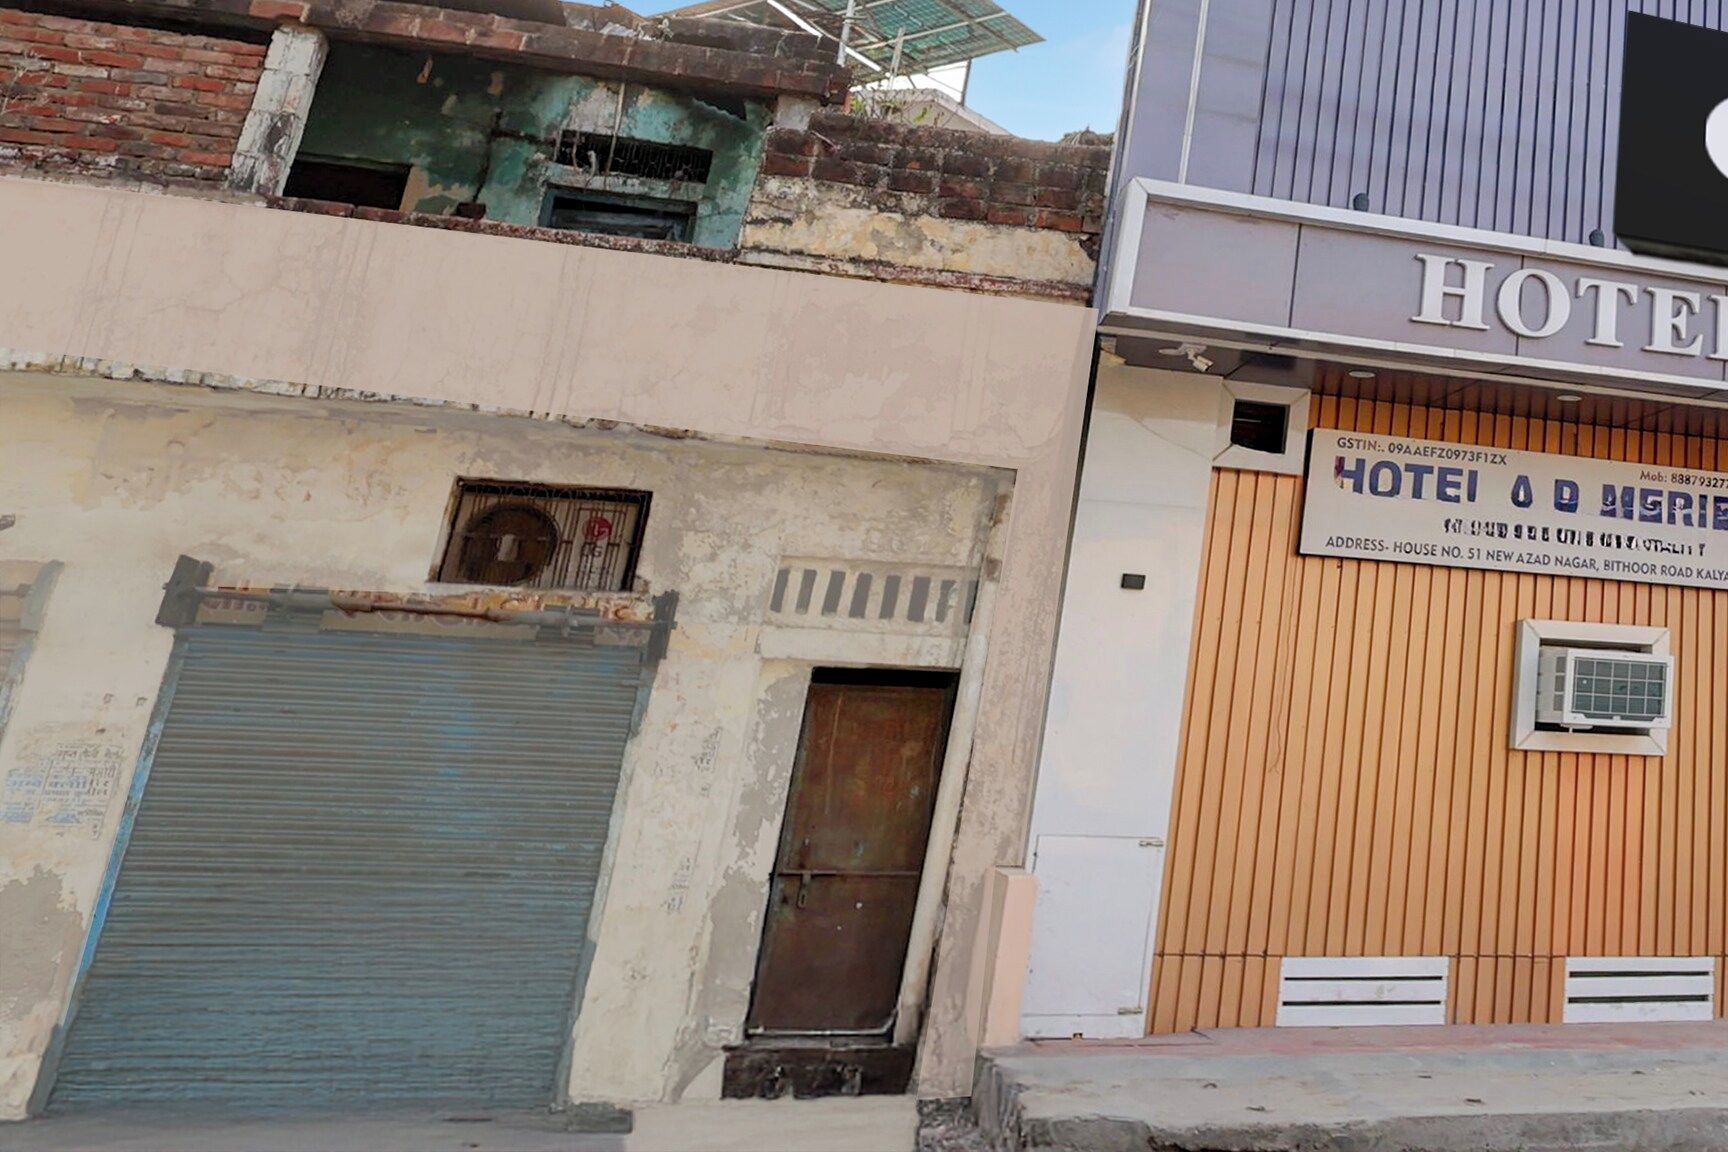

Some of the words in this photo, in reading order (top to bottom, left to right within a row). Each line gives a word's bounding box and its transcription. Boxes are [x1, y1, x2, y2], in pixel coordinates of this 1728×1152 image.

[1639, 470, 1668, 484] Mob:
[1393, 541, 1438, 557] HOUSE
[1441, 546, 1464, 560] NO.
[1467, 547, 1482, 561] 51
[1486, 549, 1514, 563] NEW
[1516, 552, 1551, 567] AZAD
[1554, 556, 1600, 572] NAGAR,
[1603, 559, 1657, 576] BITHOOR
[1660, 564, 1693, 579] ROAD
